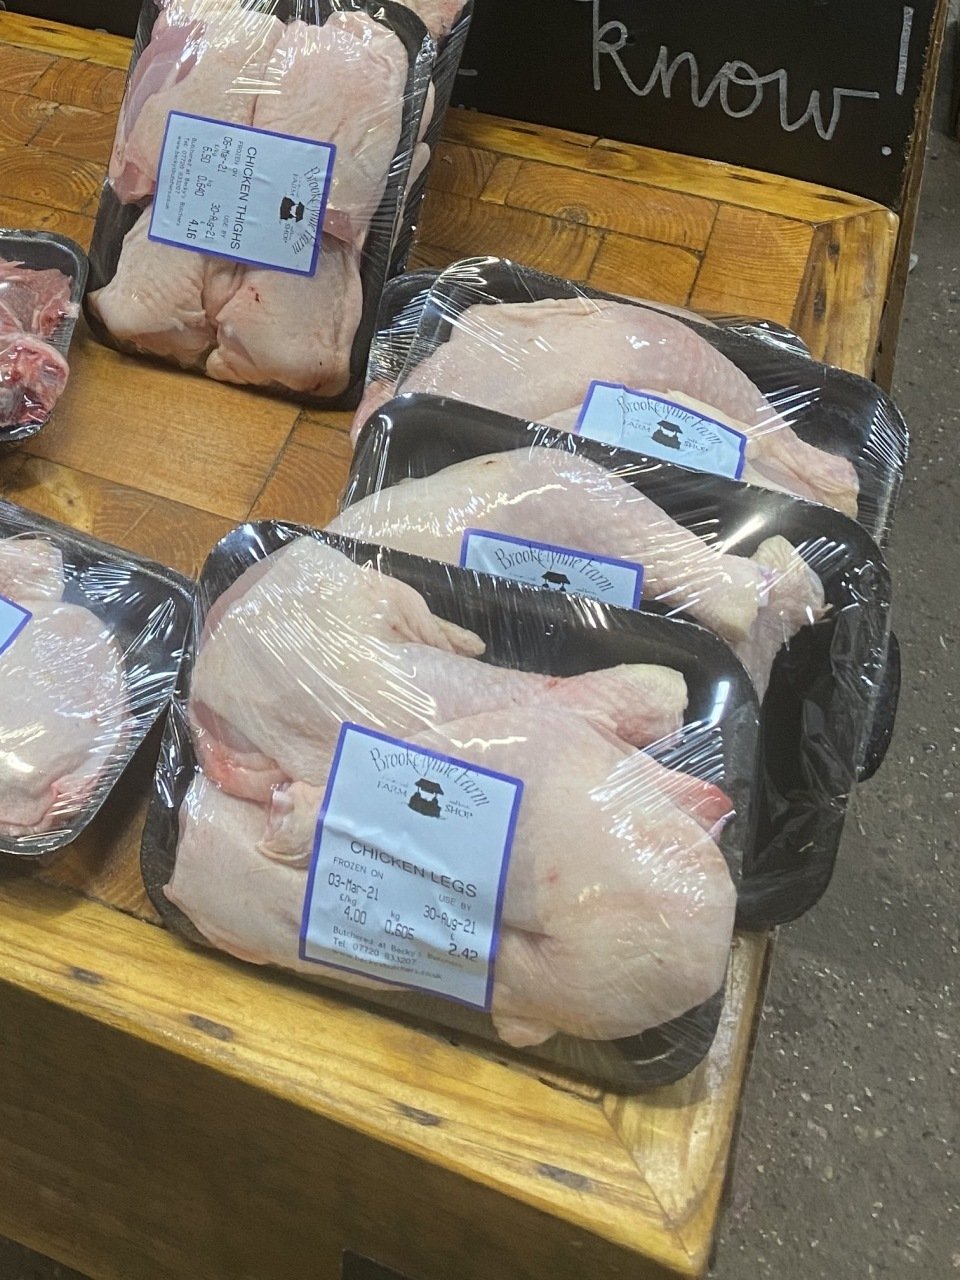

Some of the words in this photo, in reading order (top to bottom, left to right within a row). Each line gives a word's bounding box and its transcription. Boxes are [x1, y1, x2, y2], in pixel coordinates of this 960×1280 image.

[239, 146, 257, 201] CHICKEN
[186, 219, 199, 240] 4.16
[230, 205, 247, 250] THIGHS
[578, 558, 614, 592] Farm
[454, 767, 491, 807] Farm
[444, 804, 474, 819] SHOP
[333, 856, 368, 875] FROZEN
[370, 868, 385, 880] ON
[351, 840, 426, 878] CHICKEN
[431, 871, 478, 898] LEGS
[328, 872, 380, 901] 03-Mar-21
[343, 905, 367, 926] 4.00
[390, 909, 401, 921] kg
[423, 904, 477, 935] 30-Aug-21
[384, 919, 415, 941] 0.605
[447, 942, 479, 962] 2.42
